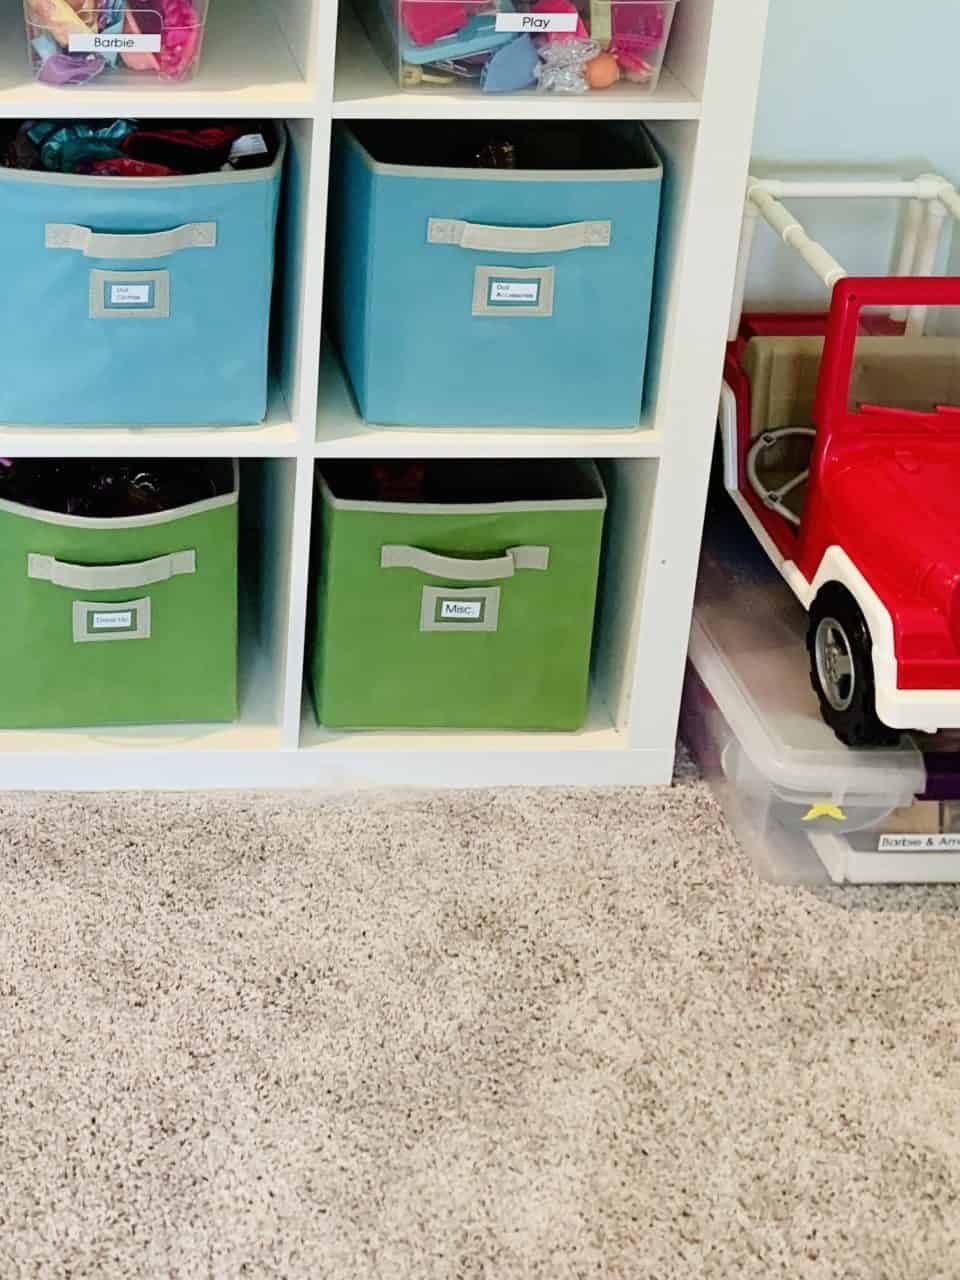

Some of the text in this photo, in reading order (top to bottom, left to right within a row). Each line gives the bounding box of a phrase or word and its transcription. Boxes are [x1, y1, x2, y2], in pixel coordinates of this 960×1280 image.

[522, 16, 551, 29] Play
[94, 37, 135, 48] Barbie
[882, 837, 921, 847] Barbie
[926, 837, 934, 847] &
